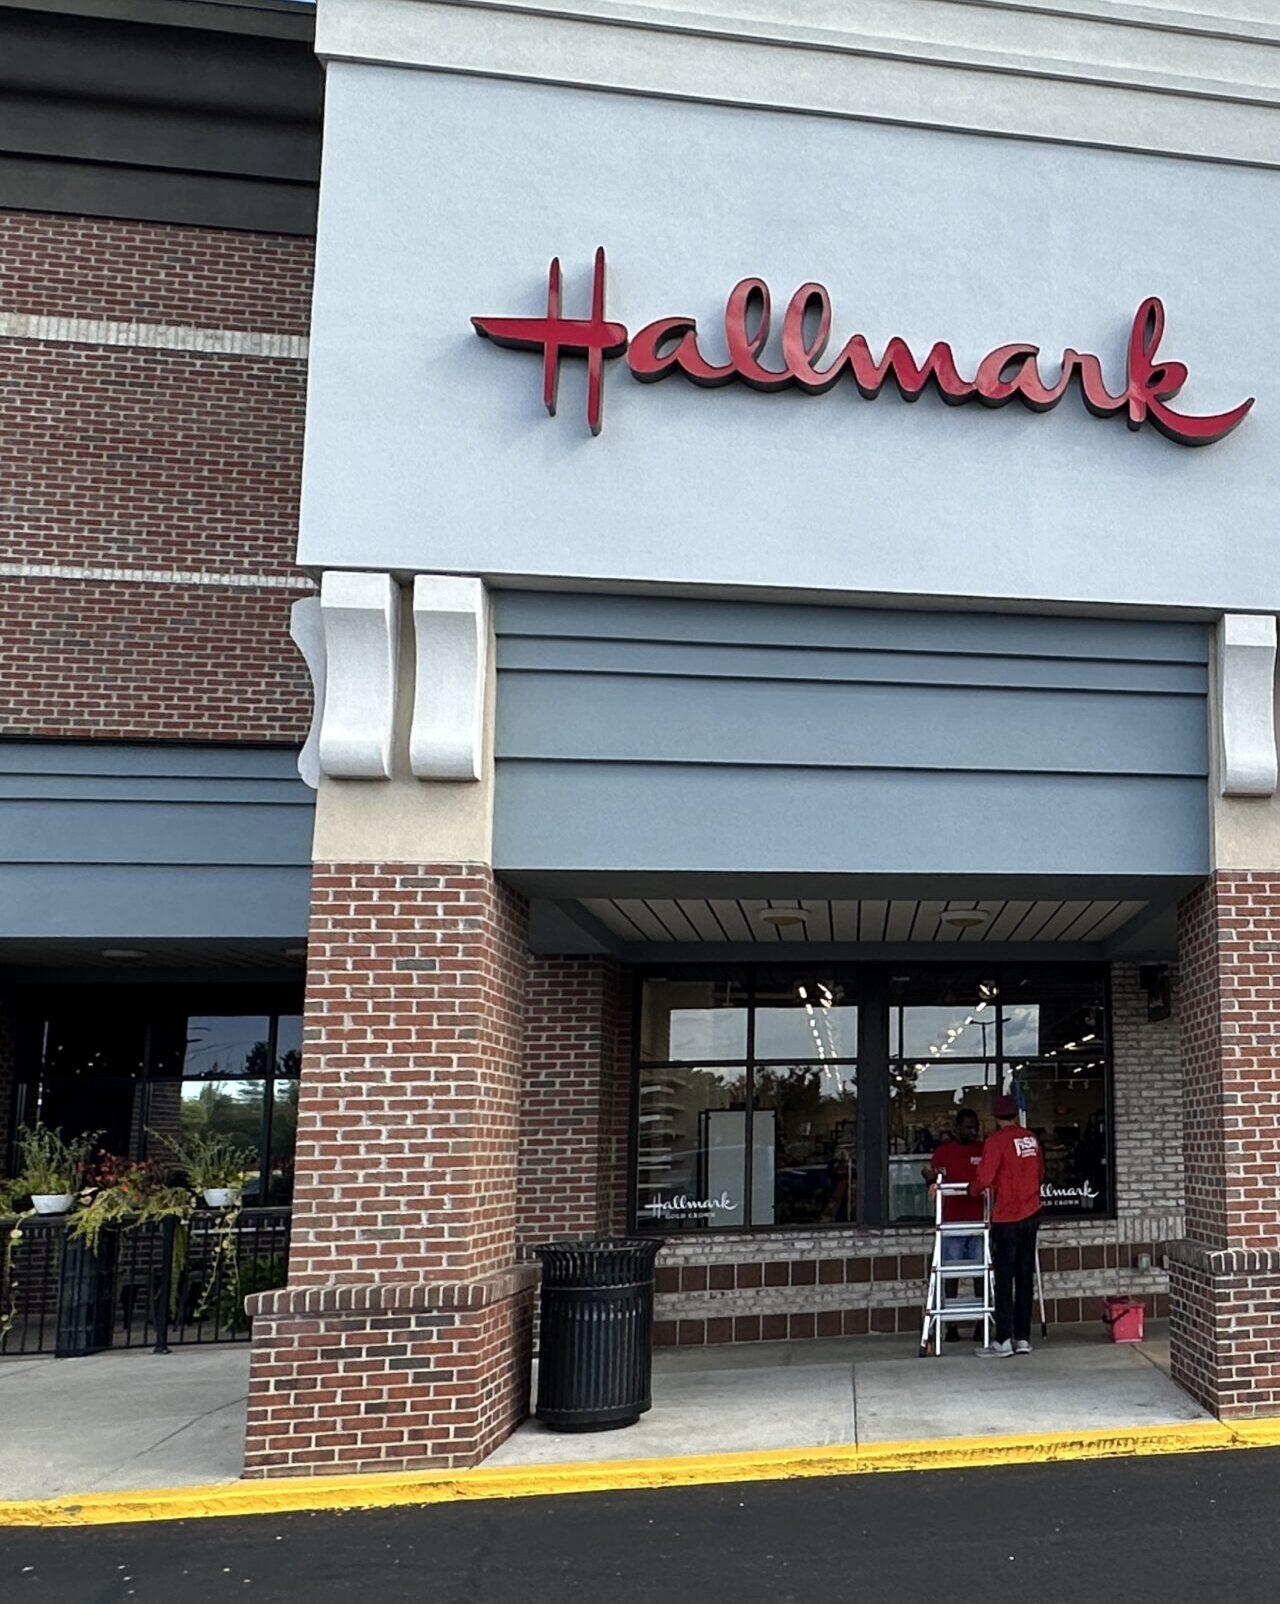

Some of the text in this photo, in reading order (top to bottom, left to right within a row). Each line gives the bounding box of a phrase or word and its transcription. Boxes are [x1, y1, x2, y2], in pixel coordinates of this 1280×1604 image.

[470, 246, 1256, 446] Hallmark
[1040, 1179, 1099, 1198] llmark
[644, 1191, 739, 1219] Hallmark
